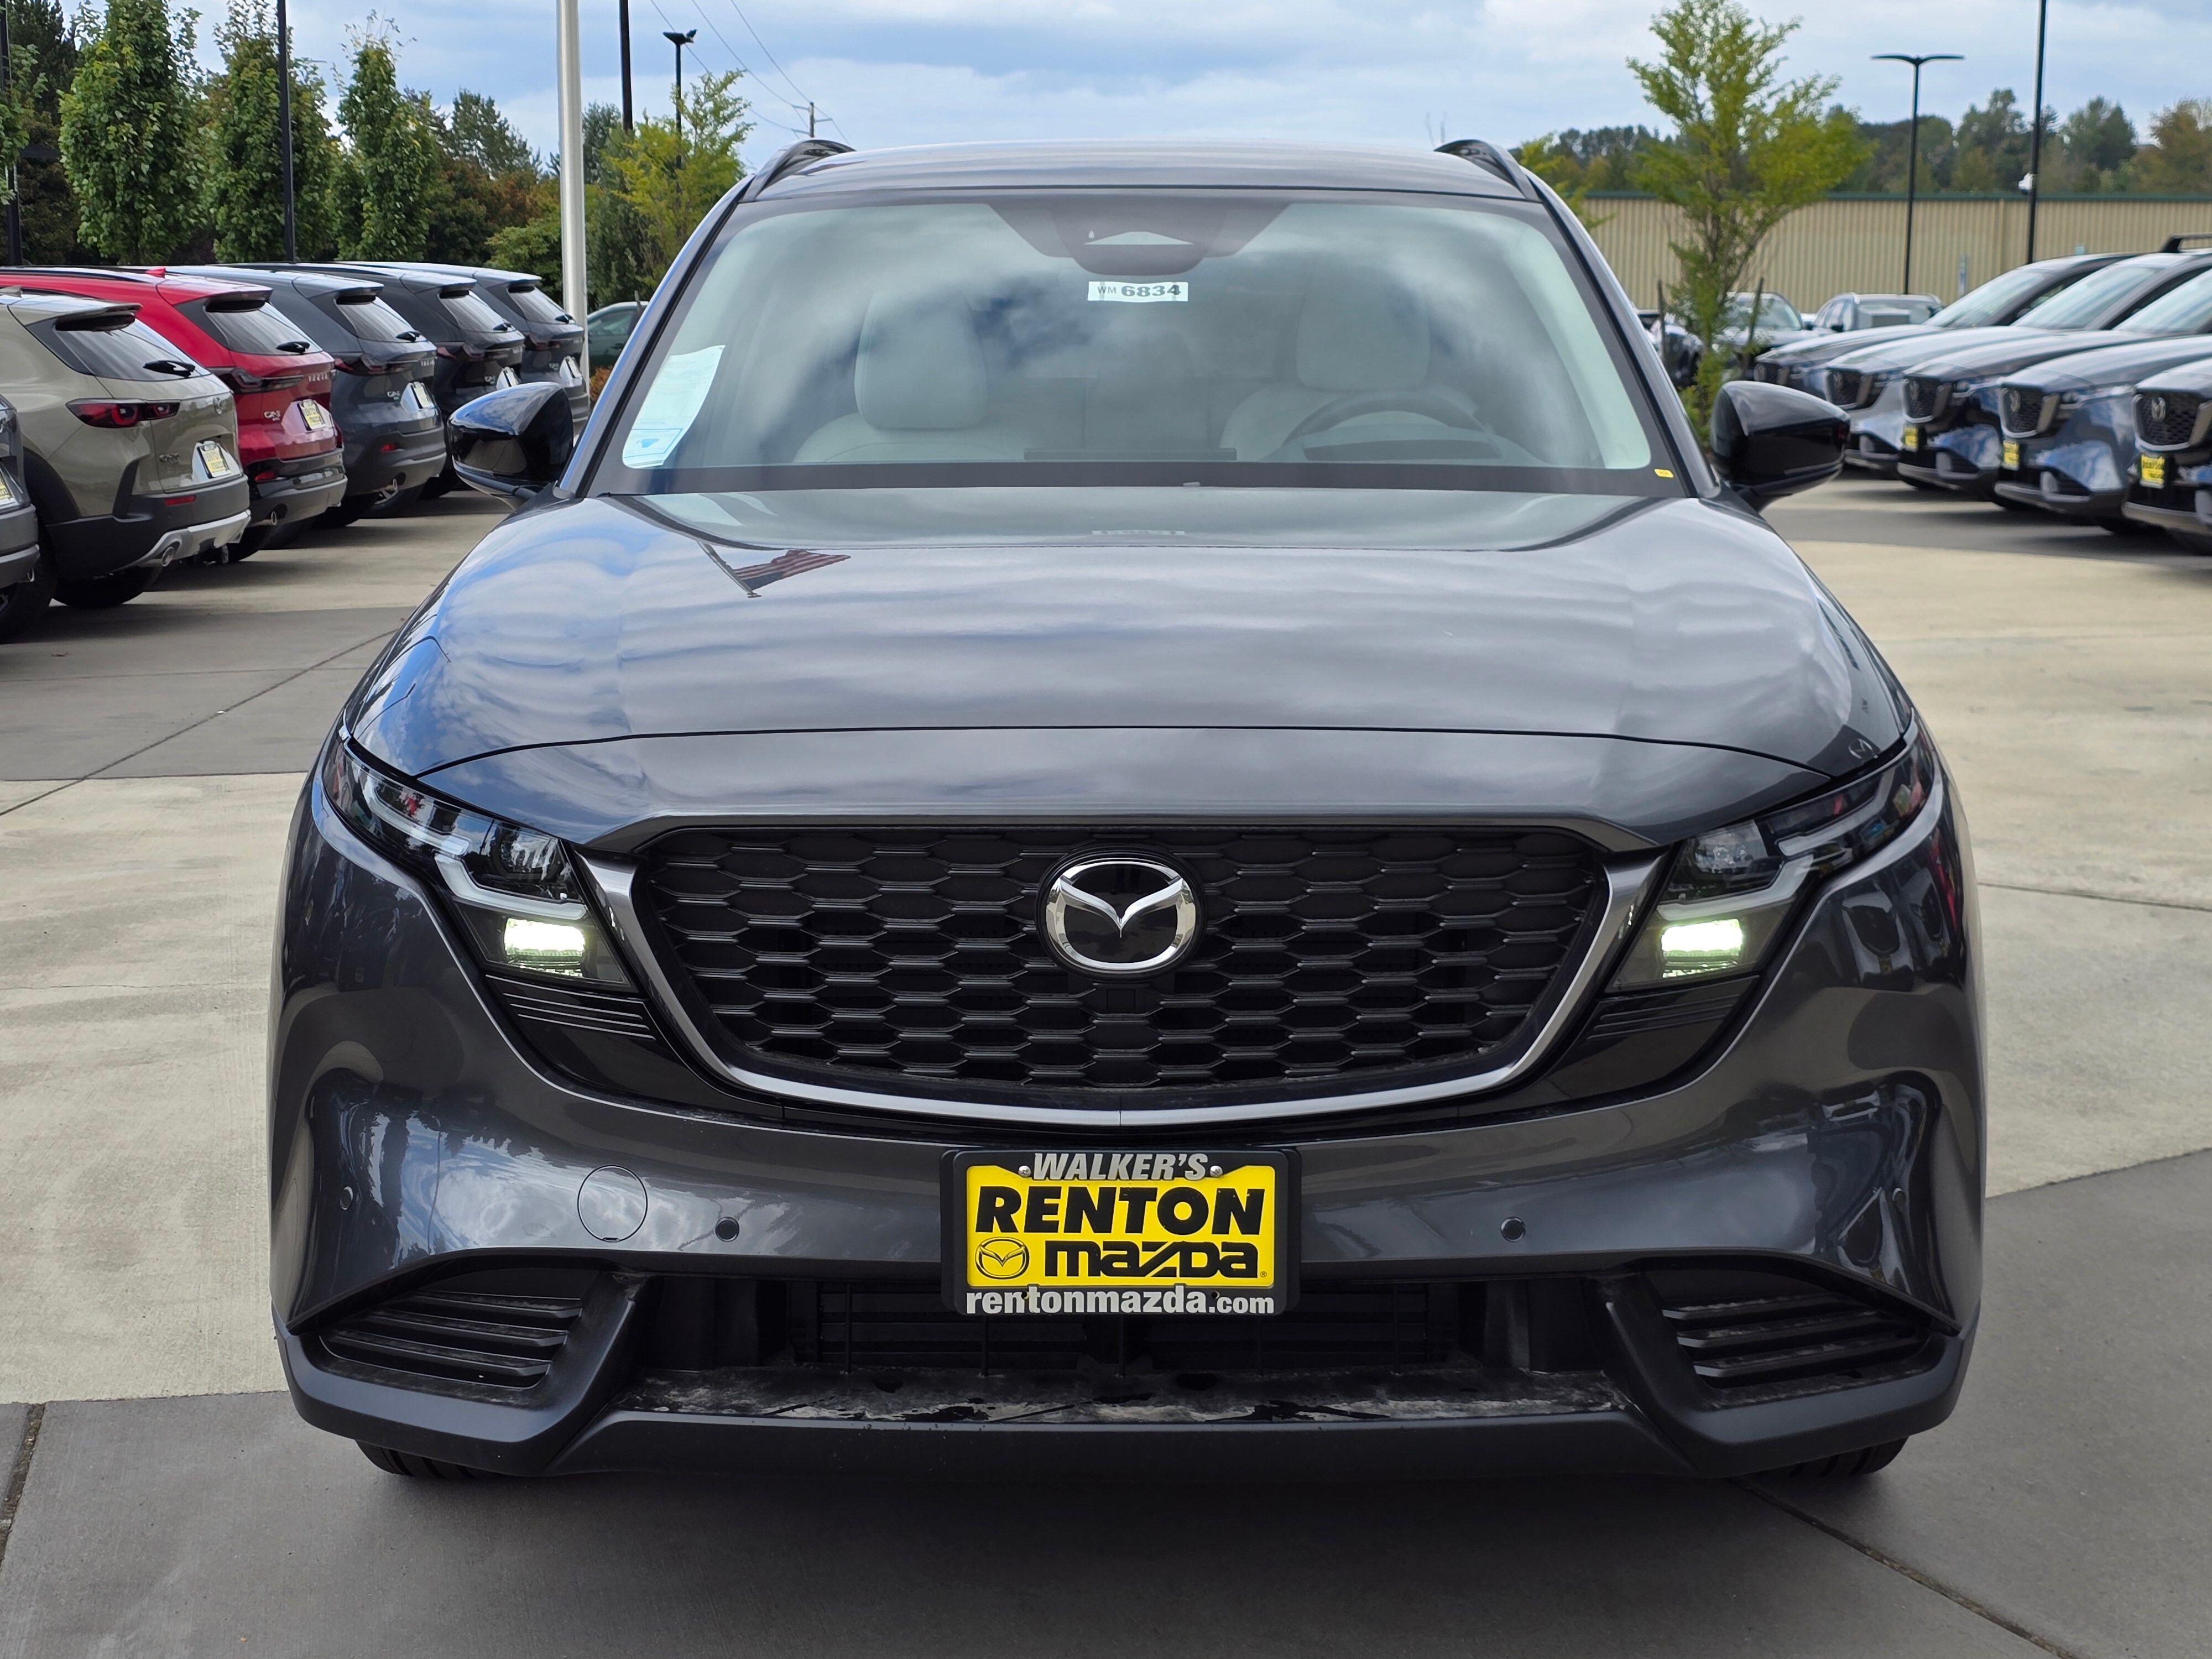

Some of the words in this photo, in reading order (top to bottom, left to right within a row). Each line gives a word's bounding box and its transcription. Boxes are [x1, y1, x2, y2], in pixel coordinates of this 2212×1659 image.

[1121, 285, 1181, 297] 6834
[1034, 1153, 1208, 1180] WALKER'S
[975, 1186, 1265, 1235] RENTON
[967, 1286, 1274, 1313] rentonmazda.com
